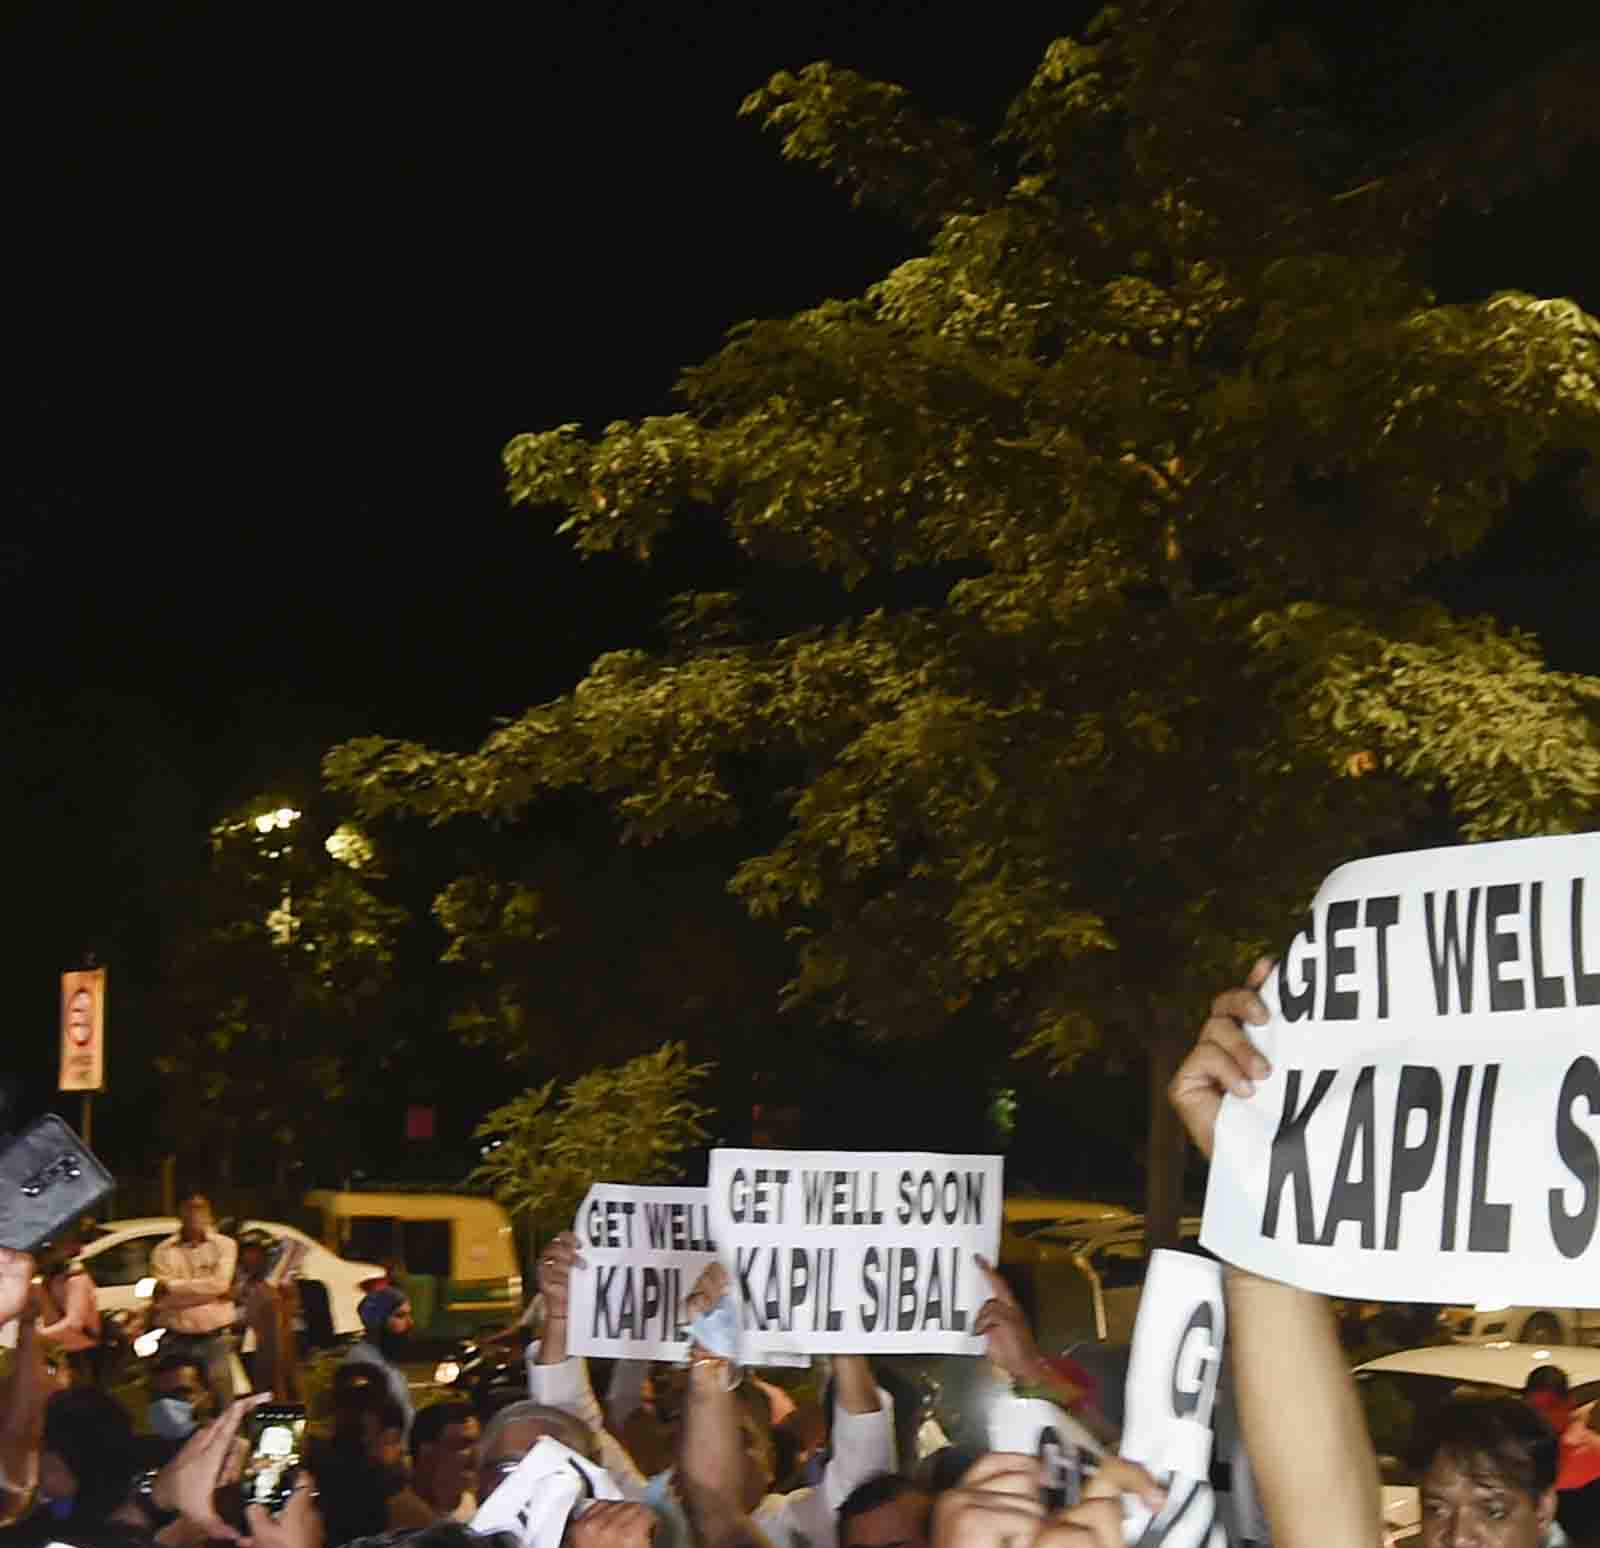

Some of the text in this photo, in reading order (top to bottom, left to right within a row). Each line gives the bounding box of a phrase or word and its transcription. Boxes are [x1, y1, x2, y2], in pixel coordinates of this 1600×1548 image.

[1279, 895, 1401, 1022] GET
[727, 1168, 985, 1225] GET WELL SOON
[1261, 1062, 1512, 1253] KAPIL
[587, 1200, 718, 1252] GET WELL
[591, 1265, 690, 1342] KAPIL
[735, 1246, 969, 1333] KAPIL SIBAL
